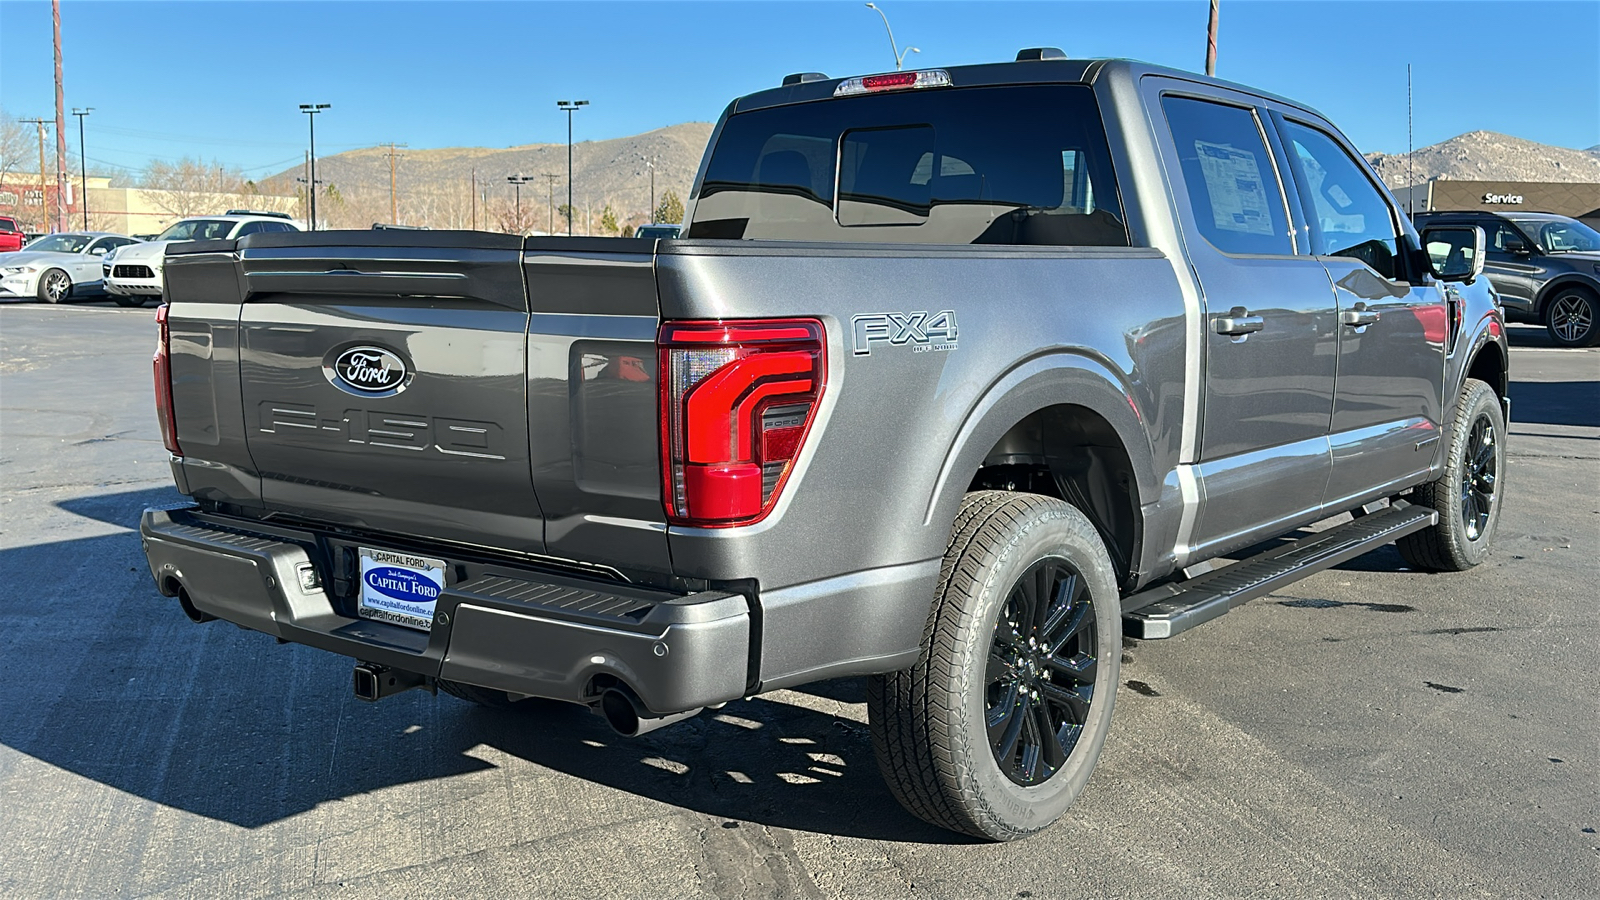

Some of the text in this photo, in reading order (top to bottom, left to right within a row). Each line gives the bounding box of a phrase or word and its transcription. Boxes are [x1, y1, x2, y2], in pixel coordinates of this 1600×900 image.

[24, 198, 43, 206] PART
[1485, 193, 1523, 204] Service
[850, 310, 959, 357] FX4
[346, 352, 392, 384] Ford
[258, 400, 505, 460] F-150
[765, 418, 799, 428] FORD
[377, 552, 425, 568] CAPITAL FORD
[367, 596, 434, 616] www.capitalfordonline.co
[360, 607, 431, 629] capitalfordonline.c
